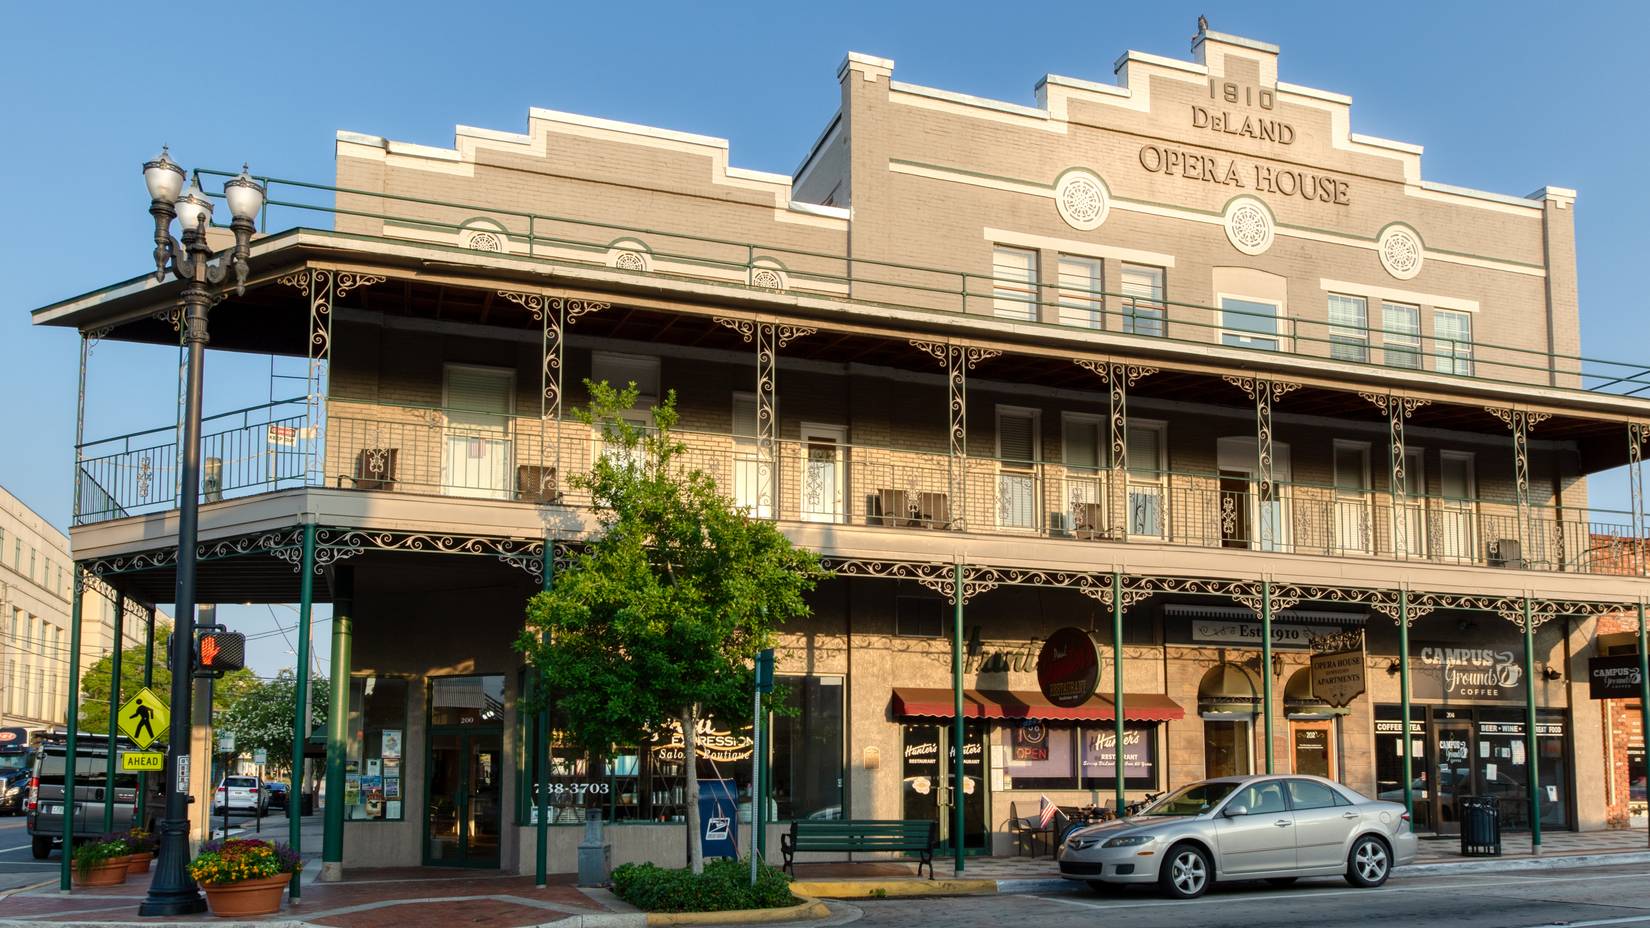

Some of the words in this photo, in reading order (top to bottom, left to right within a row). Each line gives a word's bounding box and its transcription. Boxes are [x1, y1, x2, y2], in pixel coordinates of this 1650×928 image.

[1209, 78, 1274, 111] 1910
[1139, 143, 1245, 188] OPERA
[1254, 163, 1351, 206] HOUSE
[1271, 628, 1299, 642] 1910
[1420, 647, 1494, 666] CAMPUS
[1444, 663, 1499, 693] Grounds
[1593, 667, 1630, 678] CAMPUS
[1318, 673, 1361, 686] APARTMENTS
[1459, 688, 1499, 696] COFFEE
[460, 716, 474, 724] 200
[1376, 723, 1403, 731] COFFEE
[1480, 724, 1498, 732] BEER
[1502, 725, 1519, 733] WINE
[1095, 731, 1140, 751] Huner's
[659, 748, 687, 759] Salo
[905, 743, 938, 758] Hunter's
[1016, 747, 1047, 760] OPEN
[127, 757, 159, 766] AHEAD
